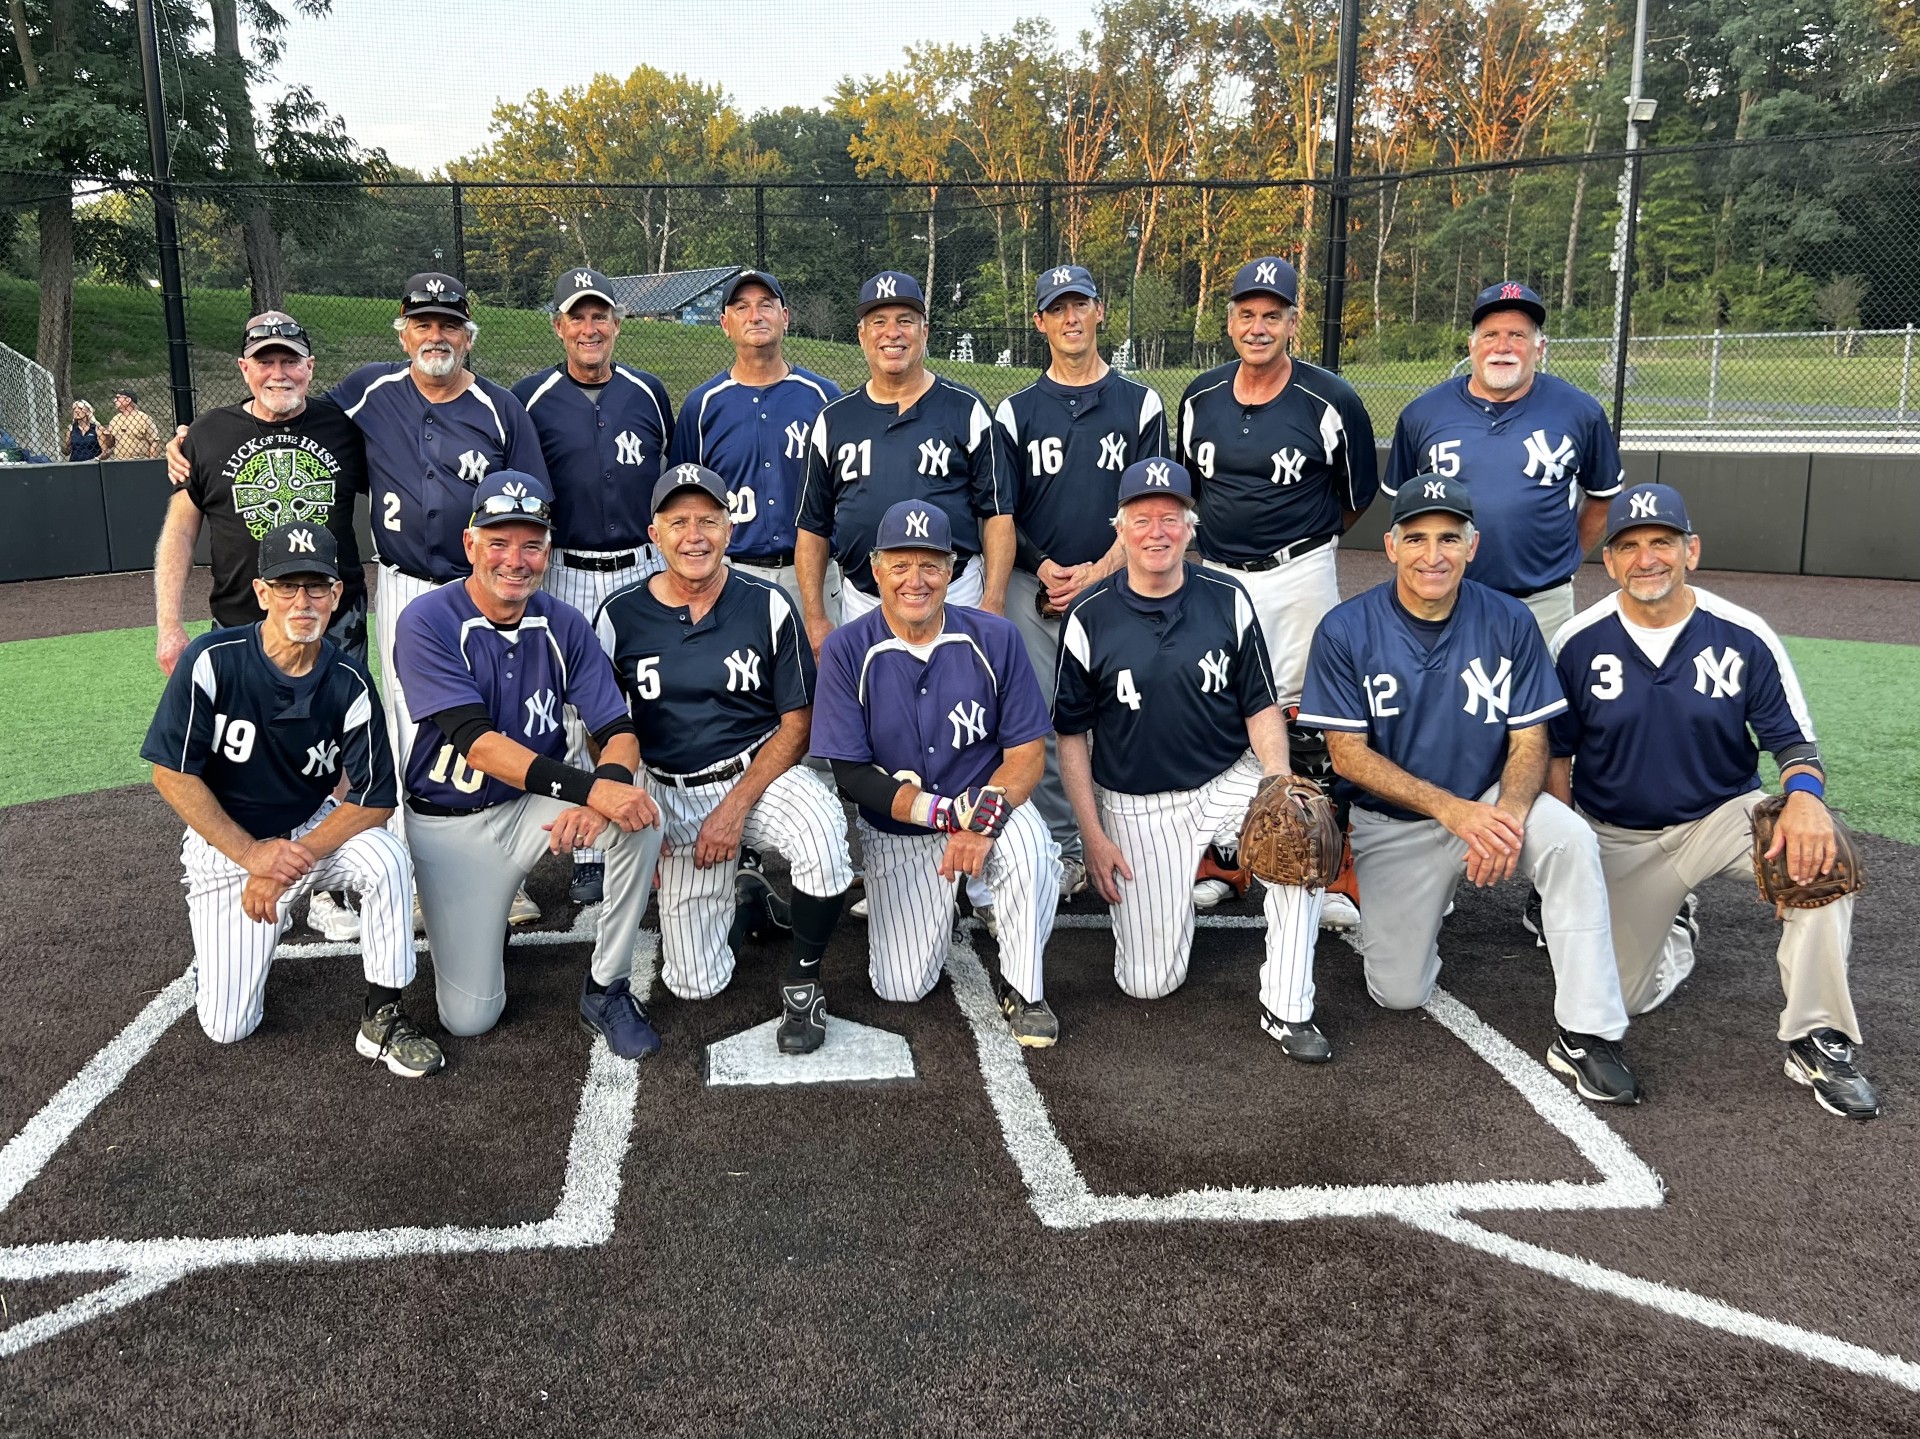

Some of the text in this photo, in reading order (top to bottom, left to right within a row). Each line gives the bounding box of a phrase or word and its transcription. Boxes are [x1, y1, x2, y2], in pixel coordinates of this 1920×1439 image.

[574, 271, 594, 288] NY
[875, 275, 897, 299] NY
[1051, 266, 1073, 286] NY
[1254, 261, 1278, 285] NY
[1500, 283, 1522, 300] NY
[222, 434, 342, 478] LUCK OF THE IRISH
[457, 449, 490, 484] NY
[614, 430, 645, 466] NY
[838, 438, 872, 482] 21
[917, 437, 951, 477] NY
[1026, 436, 1064, 477] 16
[1096, 432, 1128, 472] NY
[1197, 441, 1216, 479] 9
[1270, 447, 1307, 485] NY
[1428, 439, 1462, 478] 15
[1522, 429, 1576, 487] NY
[676, 462, 701, 485] NY
[1145, 462, 1170, 487] NY
[1423, 480, 1447, 499] NY
[383, 491, 401, 532] 2
[905, 510, 930, 538] NY
[1629, 491, 1658, 519] NY
[287, 528, 316, 553] NY
[637, 655, 661, 700] 5
[724, 648, 761, 692] NY
[1116, 668, 1142, 711] 4
[1198, 648, 1231, 693] NY
[1460, 656, 1513, 724] NY
[1590, 653, 1624, 700] 3
[1692, 645, 1744, 699] NY
[523, 688, 559, 738] NY
[1362, 673, 1400, 718] 12
[211, 713, 256, 763] 19
[947, 699, 988, 750] NY
[301, 738, 341, 778] NY
[428, 743, 485, 794] 10
